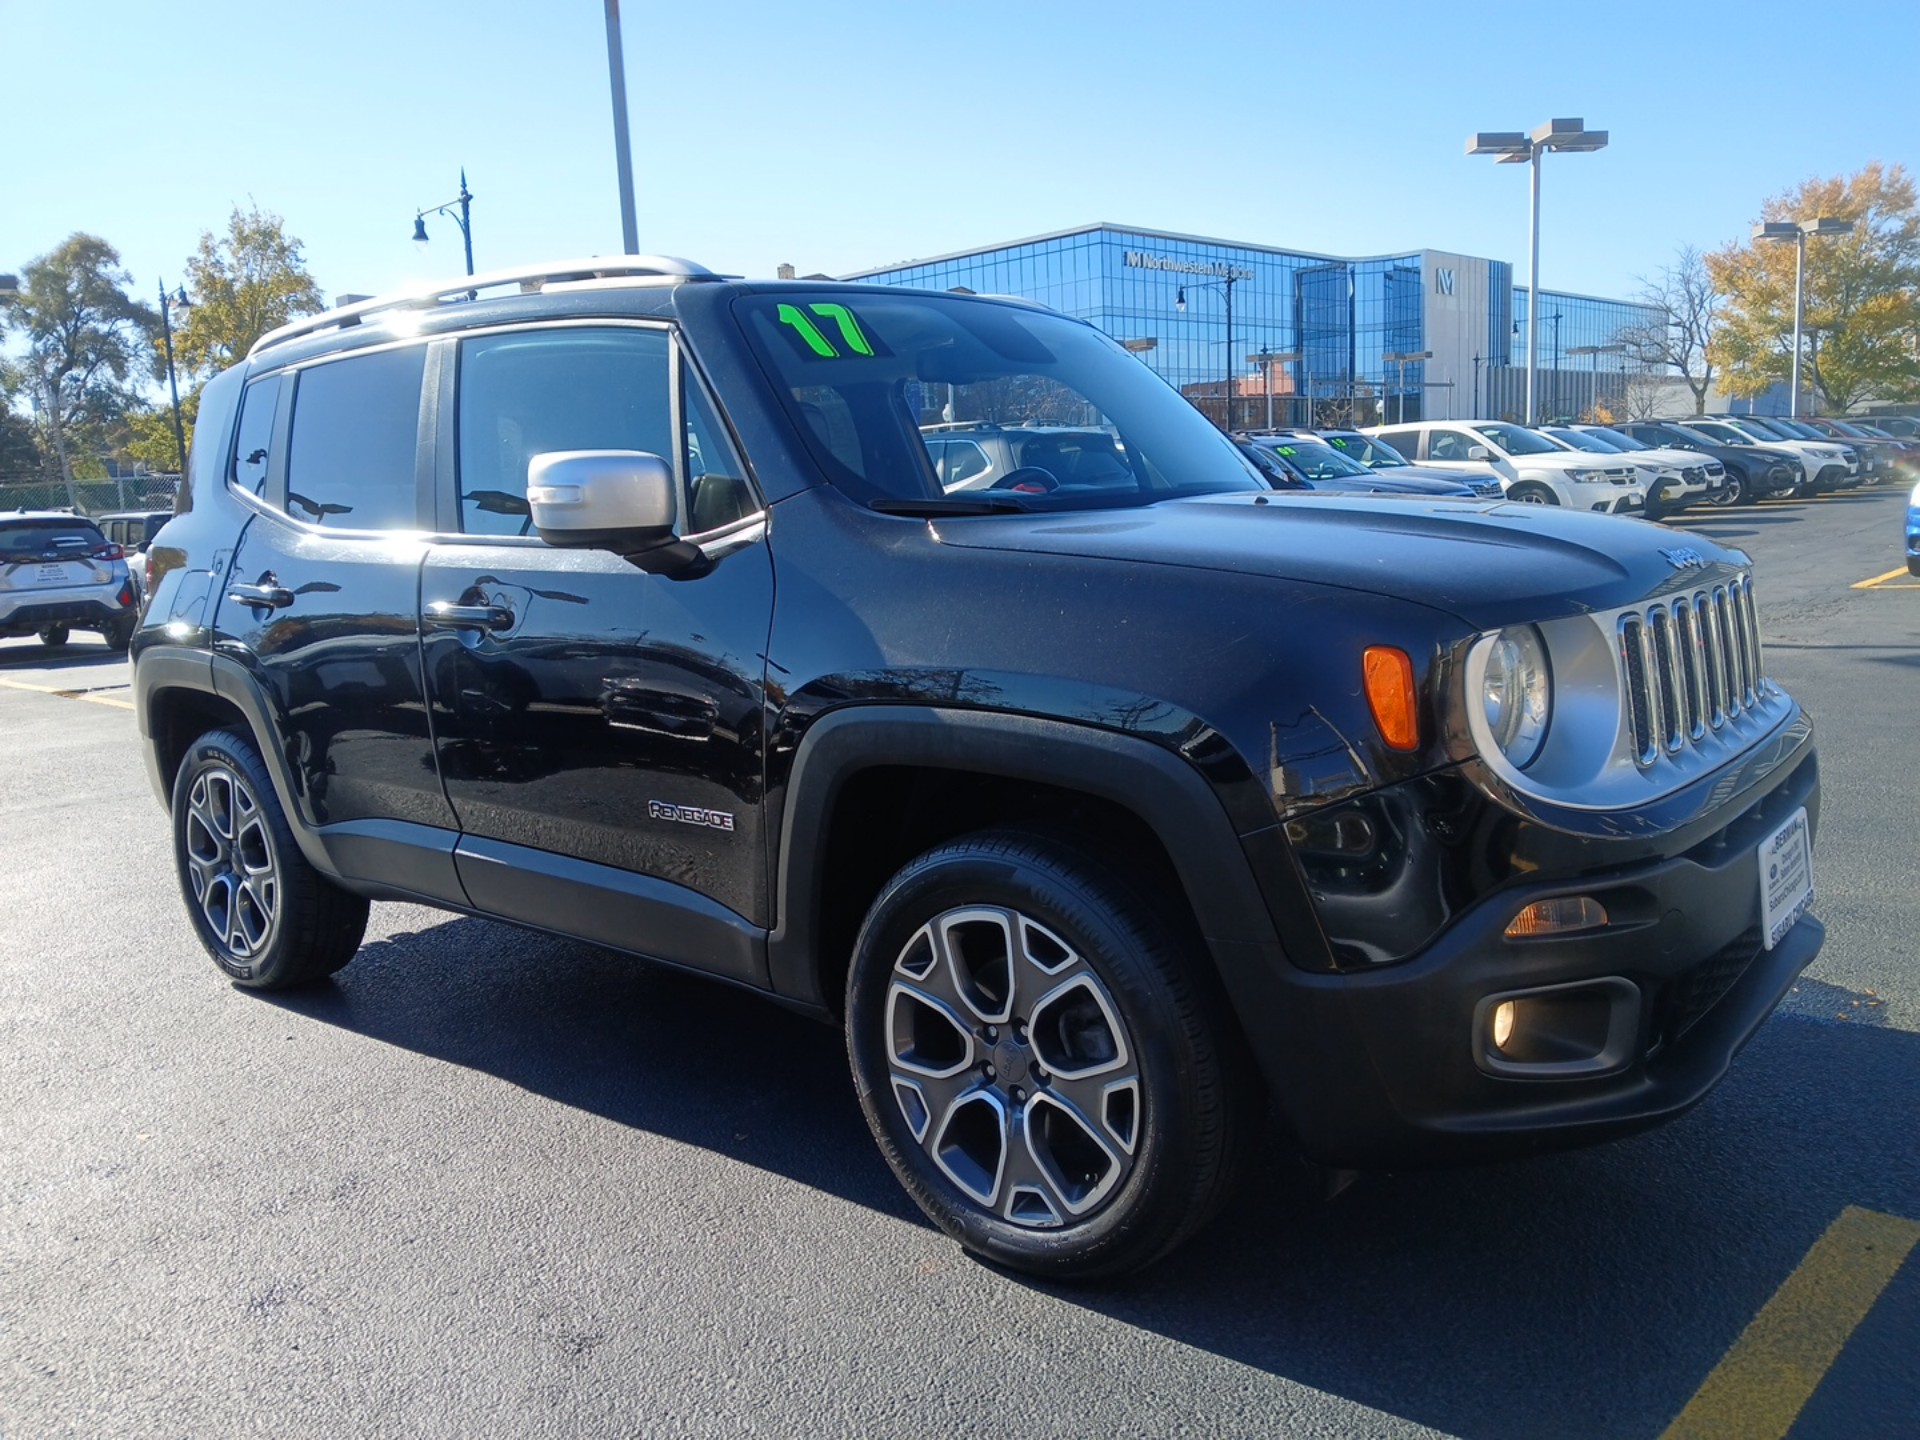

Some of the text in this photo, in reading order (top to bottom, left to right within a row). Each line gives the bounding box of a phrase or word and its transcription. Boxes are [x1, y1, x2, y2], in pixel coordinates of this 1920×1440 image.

[1141, 252, 1214, 276] Northwestern
[777, 303, 874, 357] 17
[648, 799, 735, 831] RENEGADE
